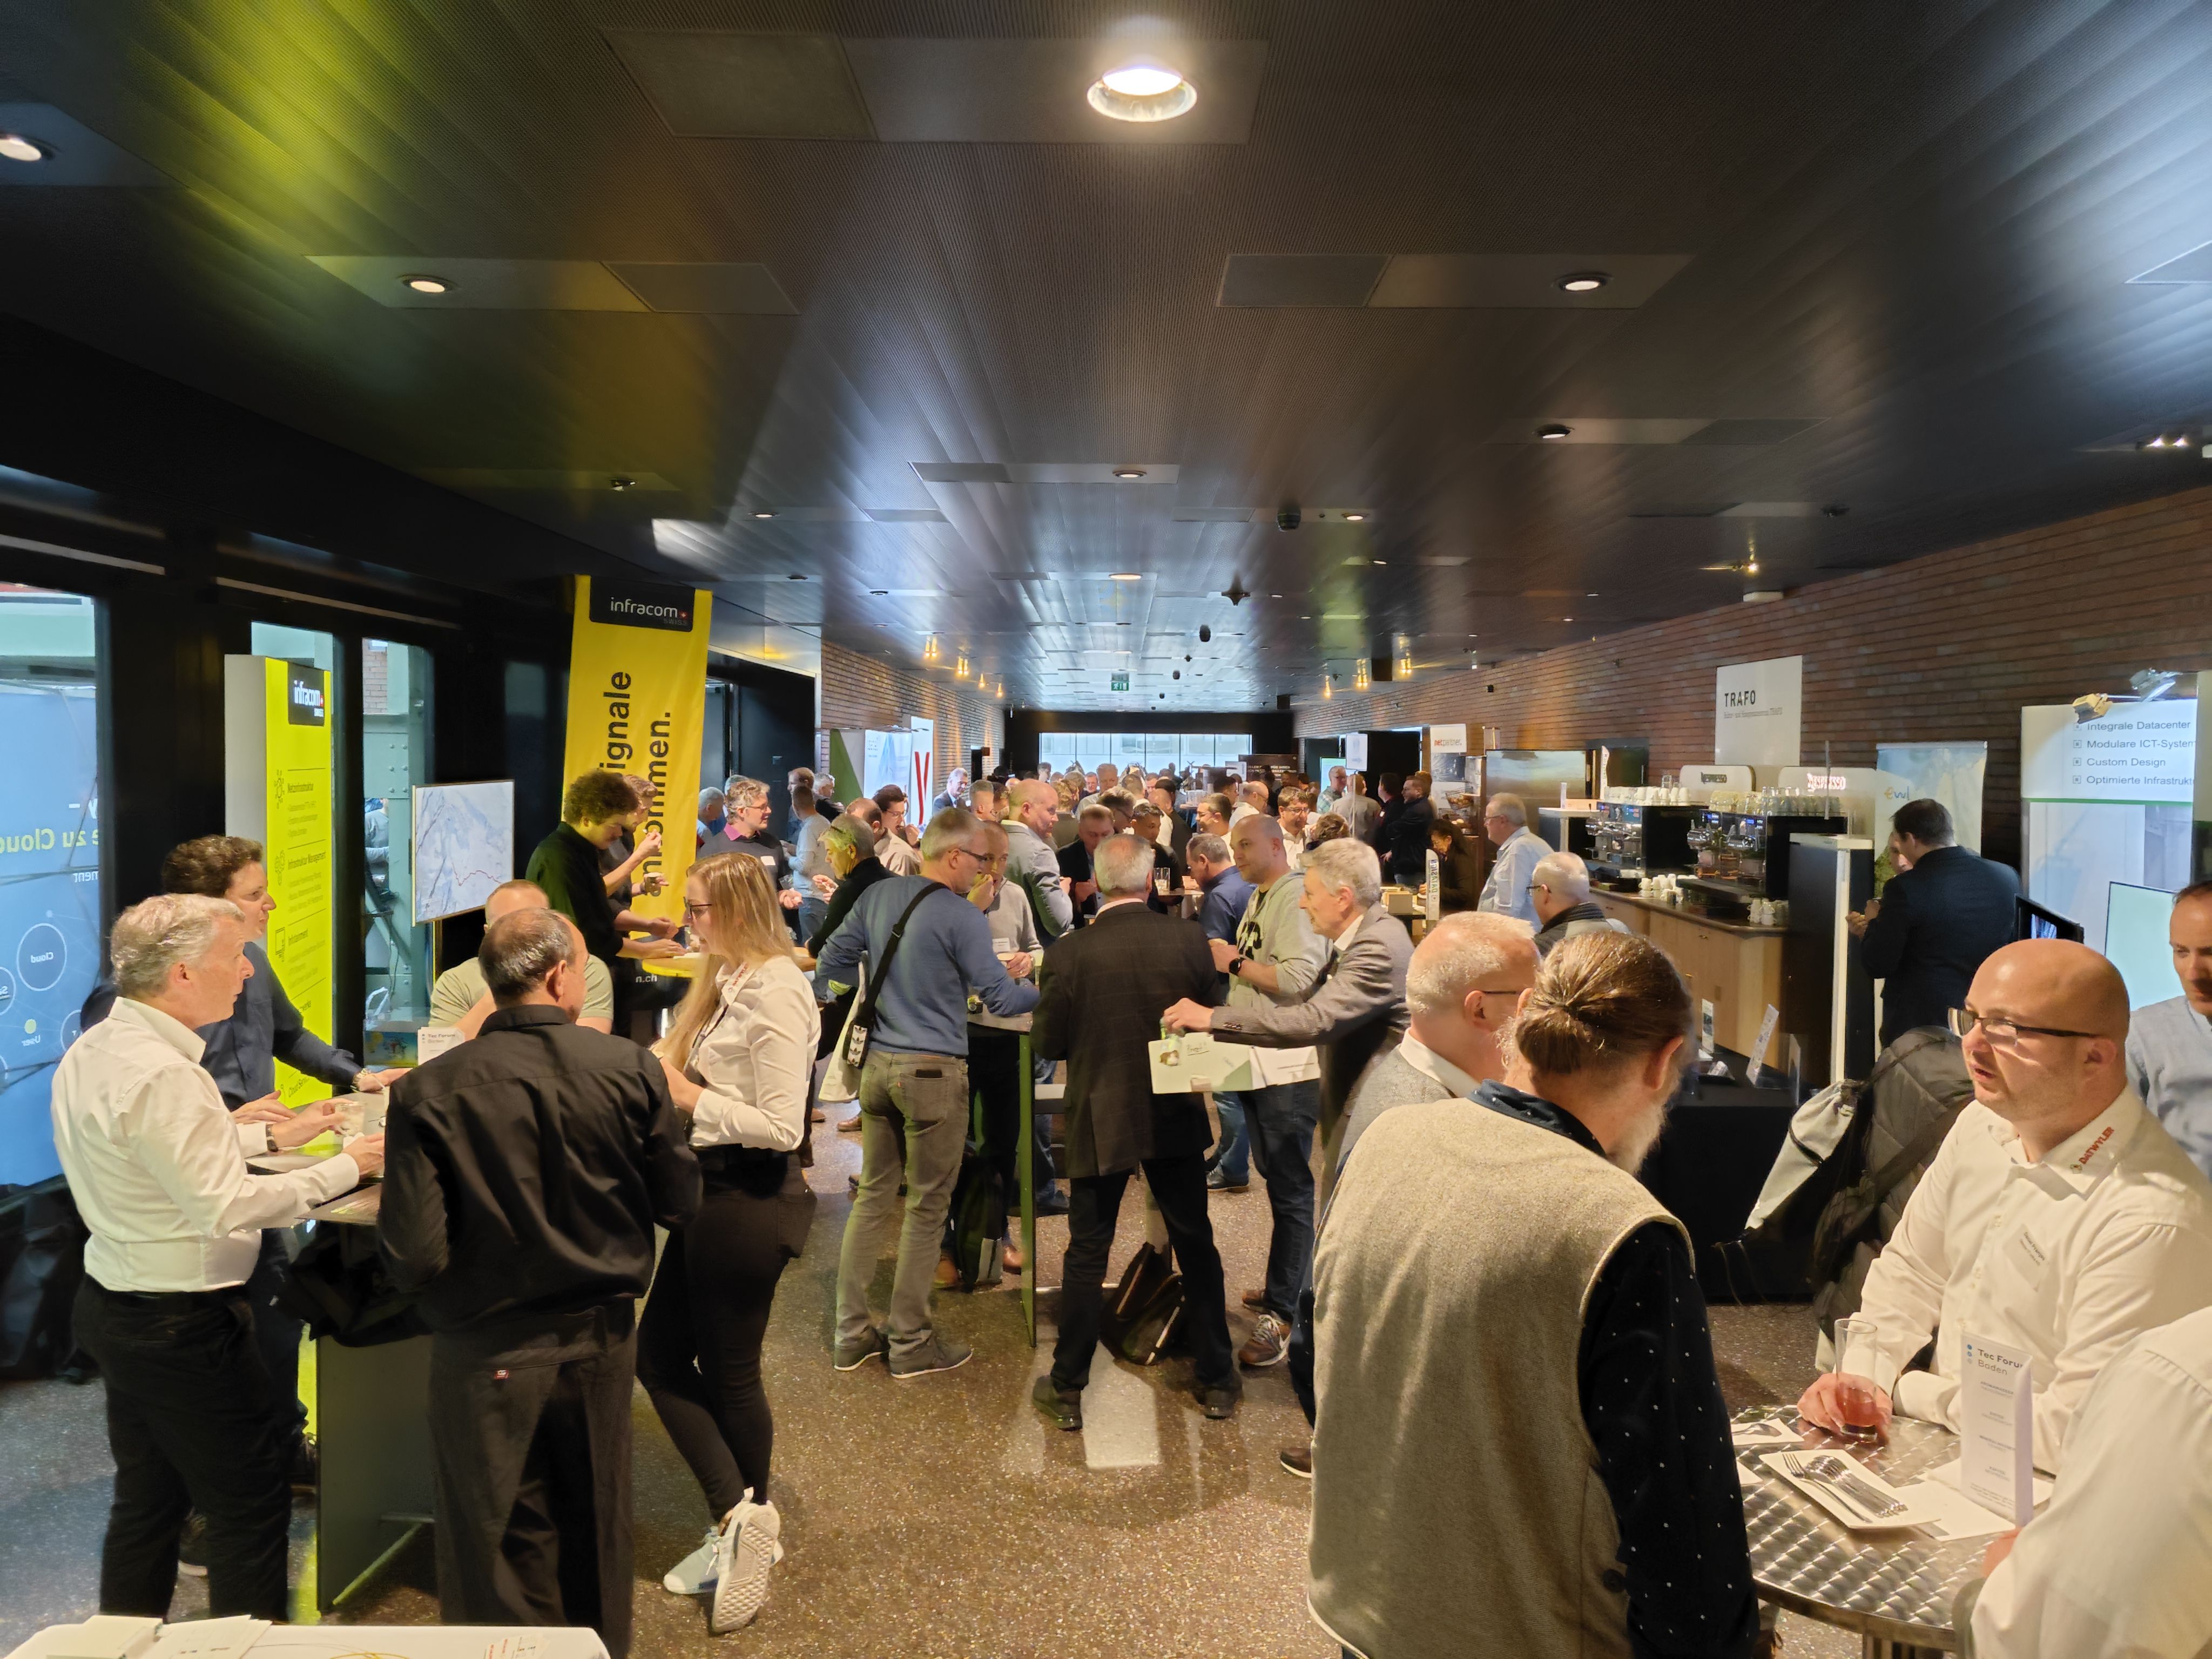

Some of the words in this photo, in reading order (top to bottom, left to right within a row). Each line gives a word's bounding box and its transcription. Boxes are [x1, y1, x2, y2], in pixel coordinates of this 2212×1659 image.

[610, 597, 678, 618] infracom
[294, 680, 320, 706] infracom
[1724, 690, 1756, 707] TRAFO
[598, 671, 632, 769] ignale
[2087, 721, 2134, 732] Integrale
[2137, 720, 2191, 730] Datacenter
[2087, 740, 2136, 748] Modulare
[2087, 758, 2128, 766] Custom
[2132, 758, 2166, 768] Design
[2087, 775, 2141, 785] Optimierte
[1884, 786, 1909, 800] ewl
[1977, 1348, 1995, 1360] Tec
[1978, 1359, 2008, 1375] Baden
